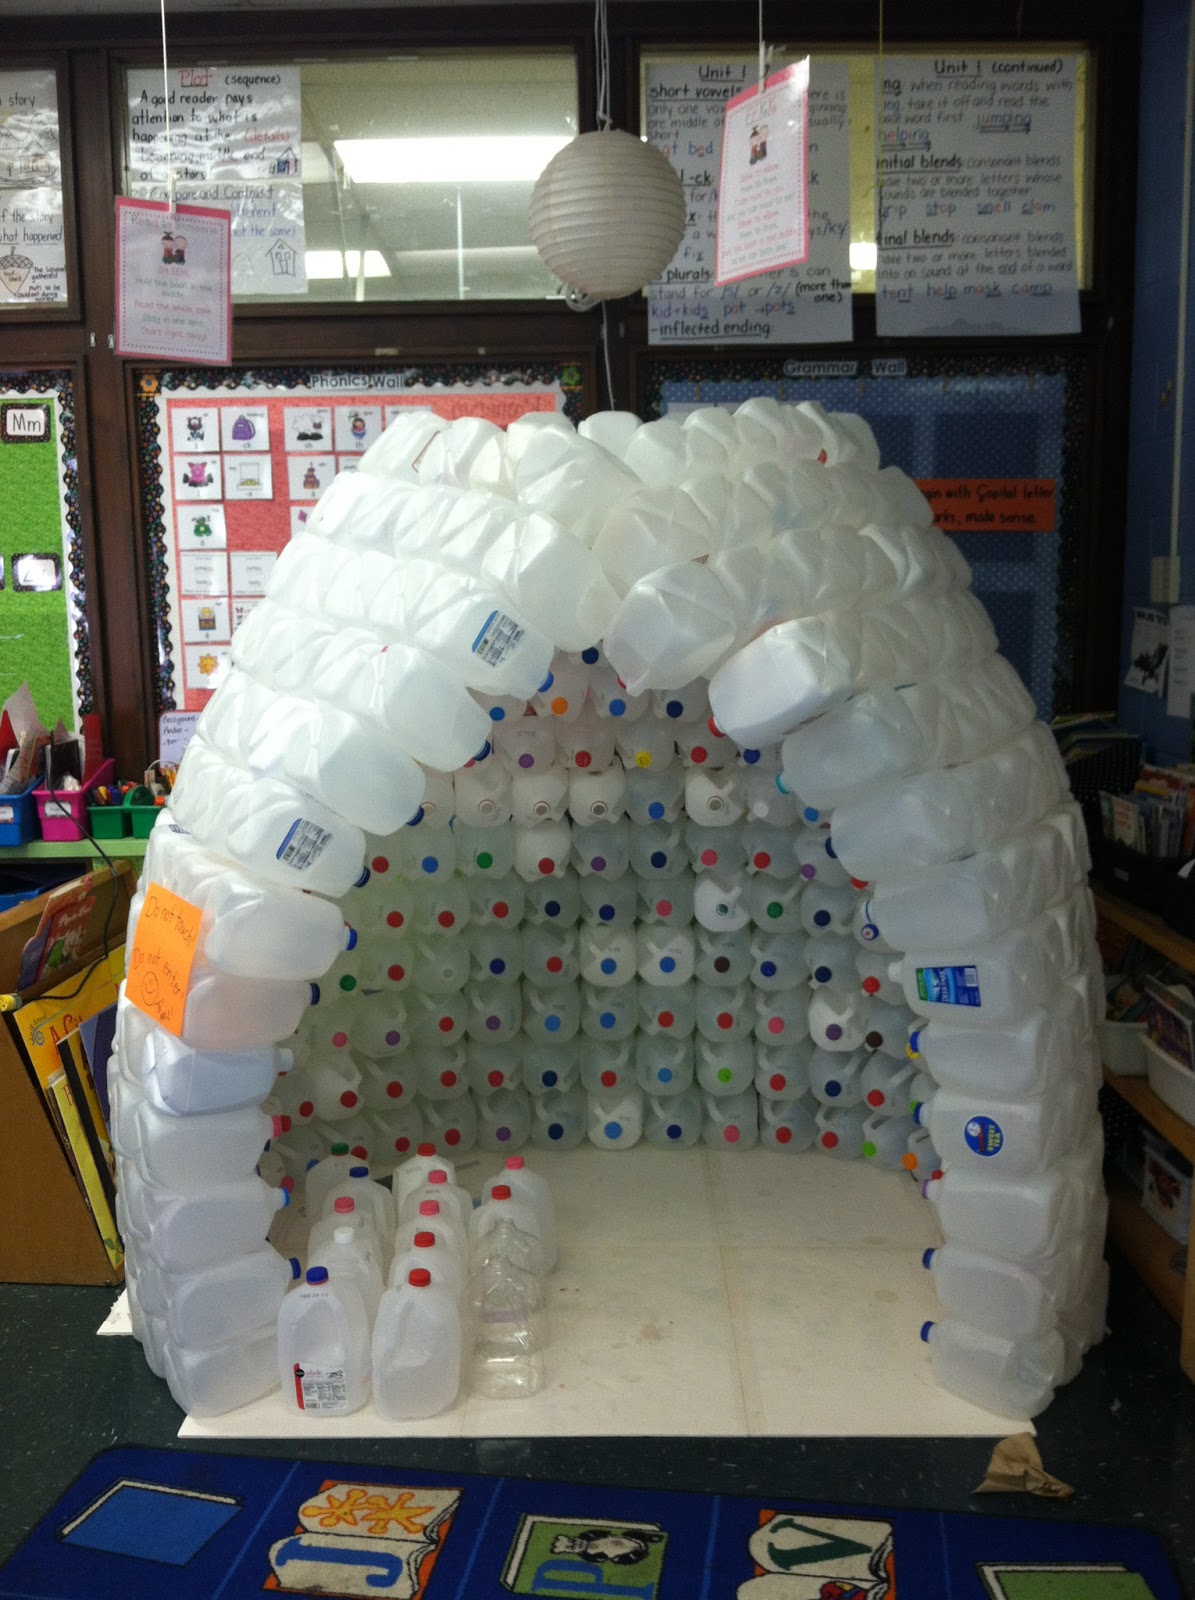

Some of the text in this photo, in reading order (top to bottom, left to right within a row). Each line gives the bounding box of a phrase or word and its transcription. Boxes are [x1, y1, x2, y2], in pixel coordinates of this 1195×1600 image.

[699, 65, 732, 80] Unit
[935, 59, 968, 75] Unit
[992, 58, 1064, 75] (continued)
[224, 75, 281, 88] (sequence)
[949, 77, 997, 97] reading
[9, 91, 36, 108] story
[140, 89, 253, 107] A good reader pays
[650, 83, 688, 98] short
[695, 86, 743, 99] vowels
[877, 155, 915, 170] initial
[920, 152, 963, 169] blends
[0, 229, 63, 246] hat happened
[913, 227, 956, 245] blends
[667, 268, 711, 285] plurals
[723, 320, 771, 339] ending
[784, 361, 857, 377] Grammar
[312, 376, 369, 389] Phonics
[13, 413, 42, 432] Mm
[145, 895, 160, 918] Do
[160, 903, 175, 923] not
[131, 947, 145, 970] Do
[147, 947, 162, 965] not
[987, 1124, 995, 1152] SWEET
[767, 1518, 873, 1571] V
